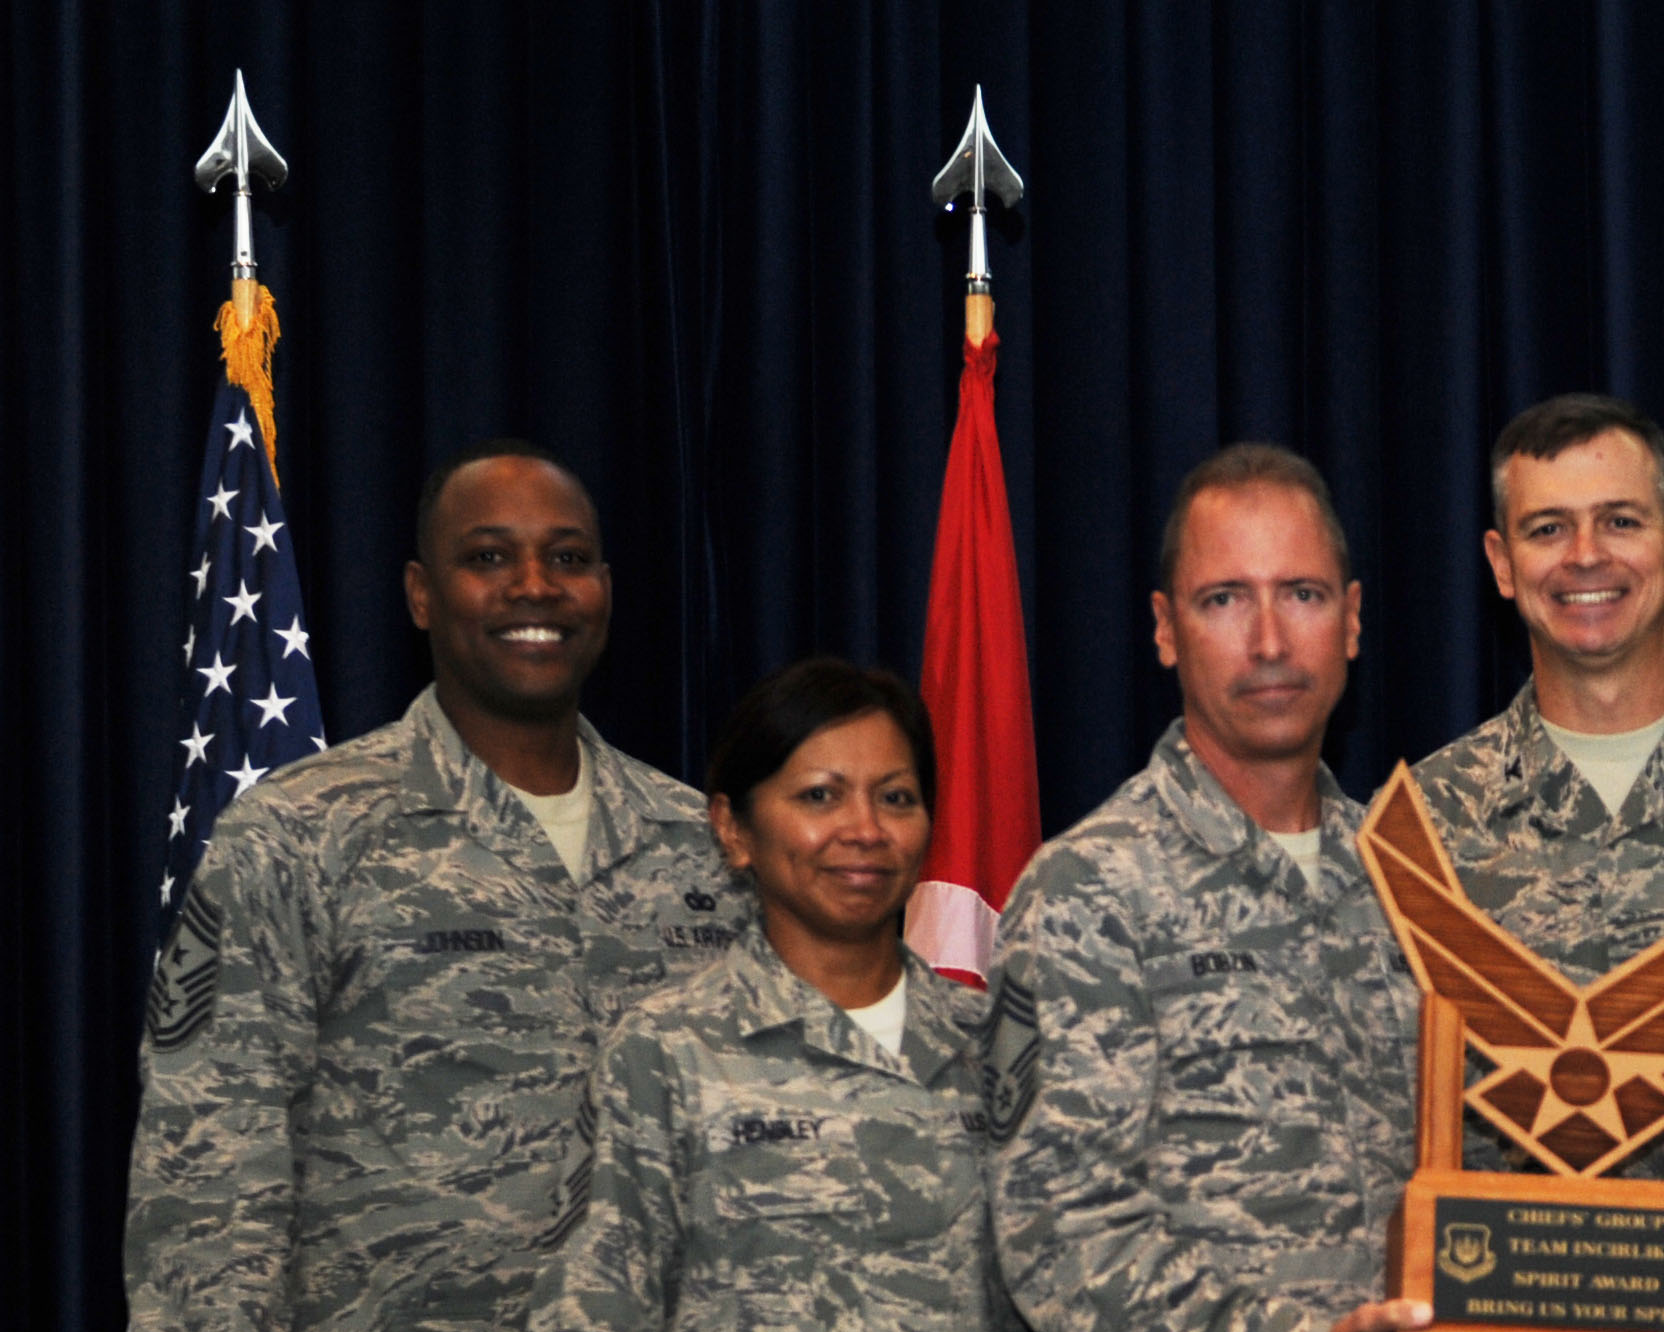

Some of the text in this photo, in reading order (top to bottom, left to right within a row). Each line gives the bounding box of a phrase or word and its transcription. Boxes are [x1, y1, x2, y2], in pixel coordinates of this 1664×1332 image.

[1508, 1237, 1570, 1256] TEAM
[1512, 1270, 1660, 1293] SPIRIT AWARD
[1466, 1299, 1533, 1317] BRING
[1539, 1301, 1566, 1318] US
[1571, 1302, 1628, 1322] YOUR
